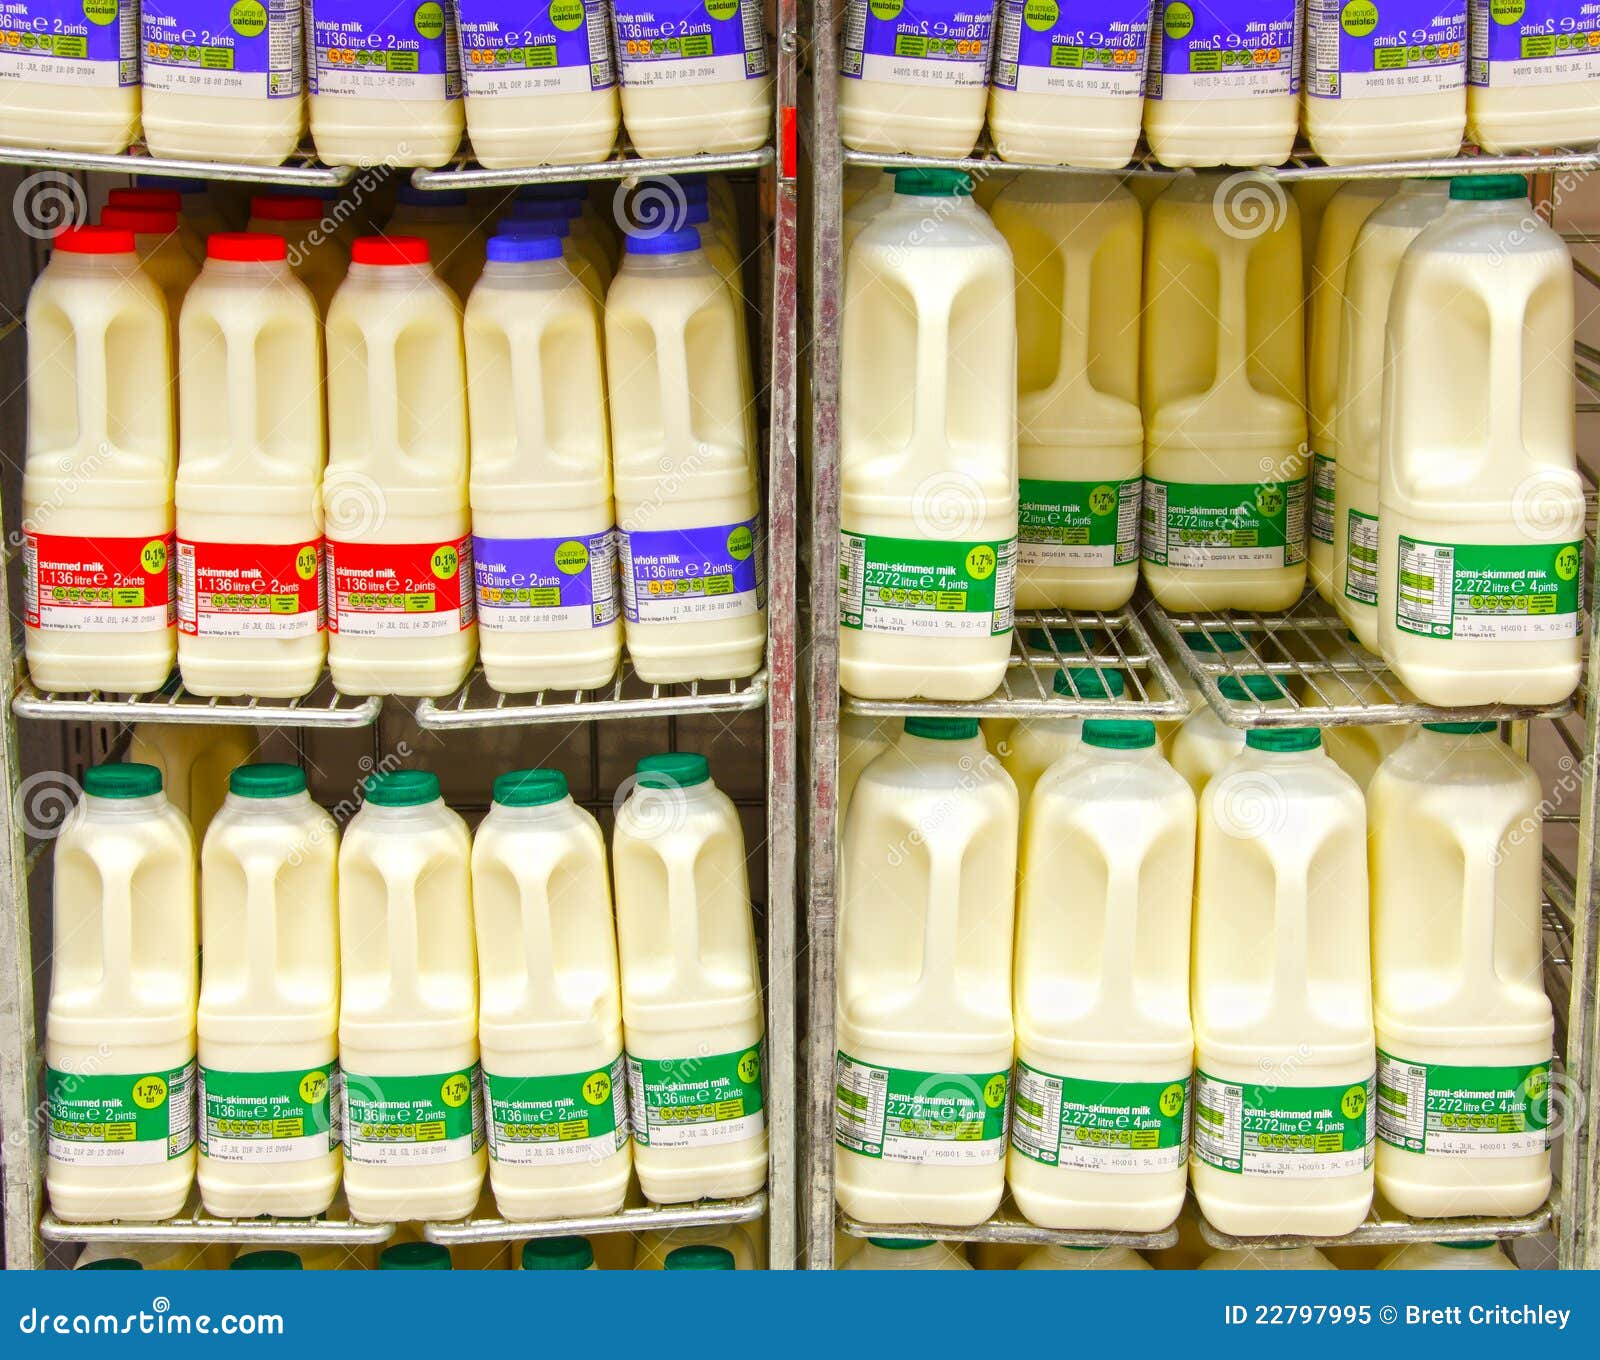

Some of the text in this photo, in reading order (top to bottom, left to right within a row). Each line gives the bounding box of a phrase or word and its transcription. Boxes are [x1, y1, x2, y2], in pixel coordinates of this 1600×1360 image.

[6, 4, 28, 14] milk
[86, 6, 115, 14] calcium
[552, 4, 568, 12] Source
[708, 1, 737, 9] calcium
[233, 8, 254, 18] Source
[552, 12, 582, 21] calcium
[636, 13, 654, 22] milk
[157, 16, 176, 27] milk
[232, 17, 264, 26] calcium
[316, 22, 362, 32] whole milk
[418, 20, 442, 28] calcium
[479, 22, 499, 31] milk
[64, 24, 88, 34] pints
[643, 25, 659, 36] litre
[690, 23, 711, 34] pints
[164, 31, 234, 46] litre pints
[316, 32, 419, 50] 1.136 litre 2 pints
[487, 36, 503, 46] litre
[534, 34, 556, 44] pints
[1093, 494, 1114, 504] 1.7%
[1260, 494, 1282, 506] 1.7%
[1062, 504, 1080, 512] milk
[1168, 506, 1248, 515] semi-skimmed milk
[1031, 515, 1091, 525] litre pints
[1168, 514, 1259, 528] 2.272 litre pints
[144, 550, 165, 561] 0.1%
[299, 555, 315, 567] 0.1%
[435, 555, 456, 566] 0.1%
[634, 555, 680, 565] whole milk
[971, 554, 993, 566] 1.7%
[1560, 554, 1577, 567] 1.7%
[40, 561, 104, 571] skimmed milk
[489, 563, 506, 573] milk
[635, 564, 732, 578] 1.136 litre pints
[867, 561, 956, 575] semi-skimmed milk
[197, 568, 262, 578] skimmed milk
[336, 568, 396, 577] skimmed milk
[1456, 569, 1547, 580] semi-skimmed milk
[40, 571, 145, 586] 1.136 litre pints
[495, 576, 560, 586] litre pints
[866, 572, 968, 590] 2.272 litre 4 pints
[198, 578, 299, 593] 1.136 litre pints
[337, 578, 435, 591] 1.136 litre pints
[1454, 579, 1558, 593] 2.272 litre 4 pints
[446, 1083, 468, 1095] 1.7%
[587, 1079, 608, 1093] 1.7%
[645, 1077, 730, 1091] semi-skimmed milk
[137, 1085, 163, 1096] 1.7%
[1428, 1088, 1516, 1099] semi-skimmed milk
[270, 1095, 290, 1104] milk
[555, 1098, 574, 1107] milk
[646, 1089, 743, 1105] 1.136 litre pints
[888, 1092, 975, 1106] semi-skimmed milk
[1163, 1092, 1182, 1105] 1.7%
[1346, 1094, 1363, 1107] 1.7%
[102, 1099, 123, 1107] milk
[413, 1100, 432, 1108] milk
[1063, 1101, 1150, 1115] semi-skimmed milk
[1427, 1098, 1527, 1112] 2.272 litre pints
[69, 1110, 136, 1120] litre pints
[208, 1102, 304, 1117] 1.136 litre pints
[350, 1107, 446, 1121] 1.136 litre pints
[494, 1108, 588, 1121] 1.136 litre pints
[887, 1102, 985, 1119] 2.272 litre pints
[1245, 1108, 1332, 1119] semi-skimmed milk
[1062, 1111, 1161, 1129] 2.272 litre pints
[1244, 1117, 1344, 1133] 2.272 litre pints
